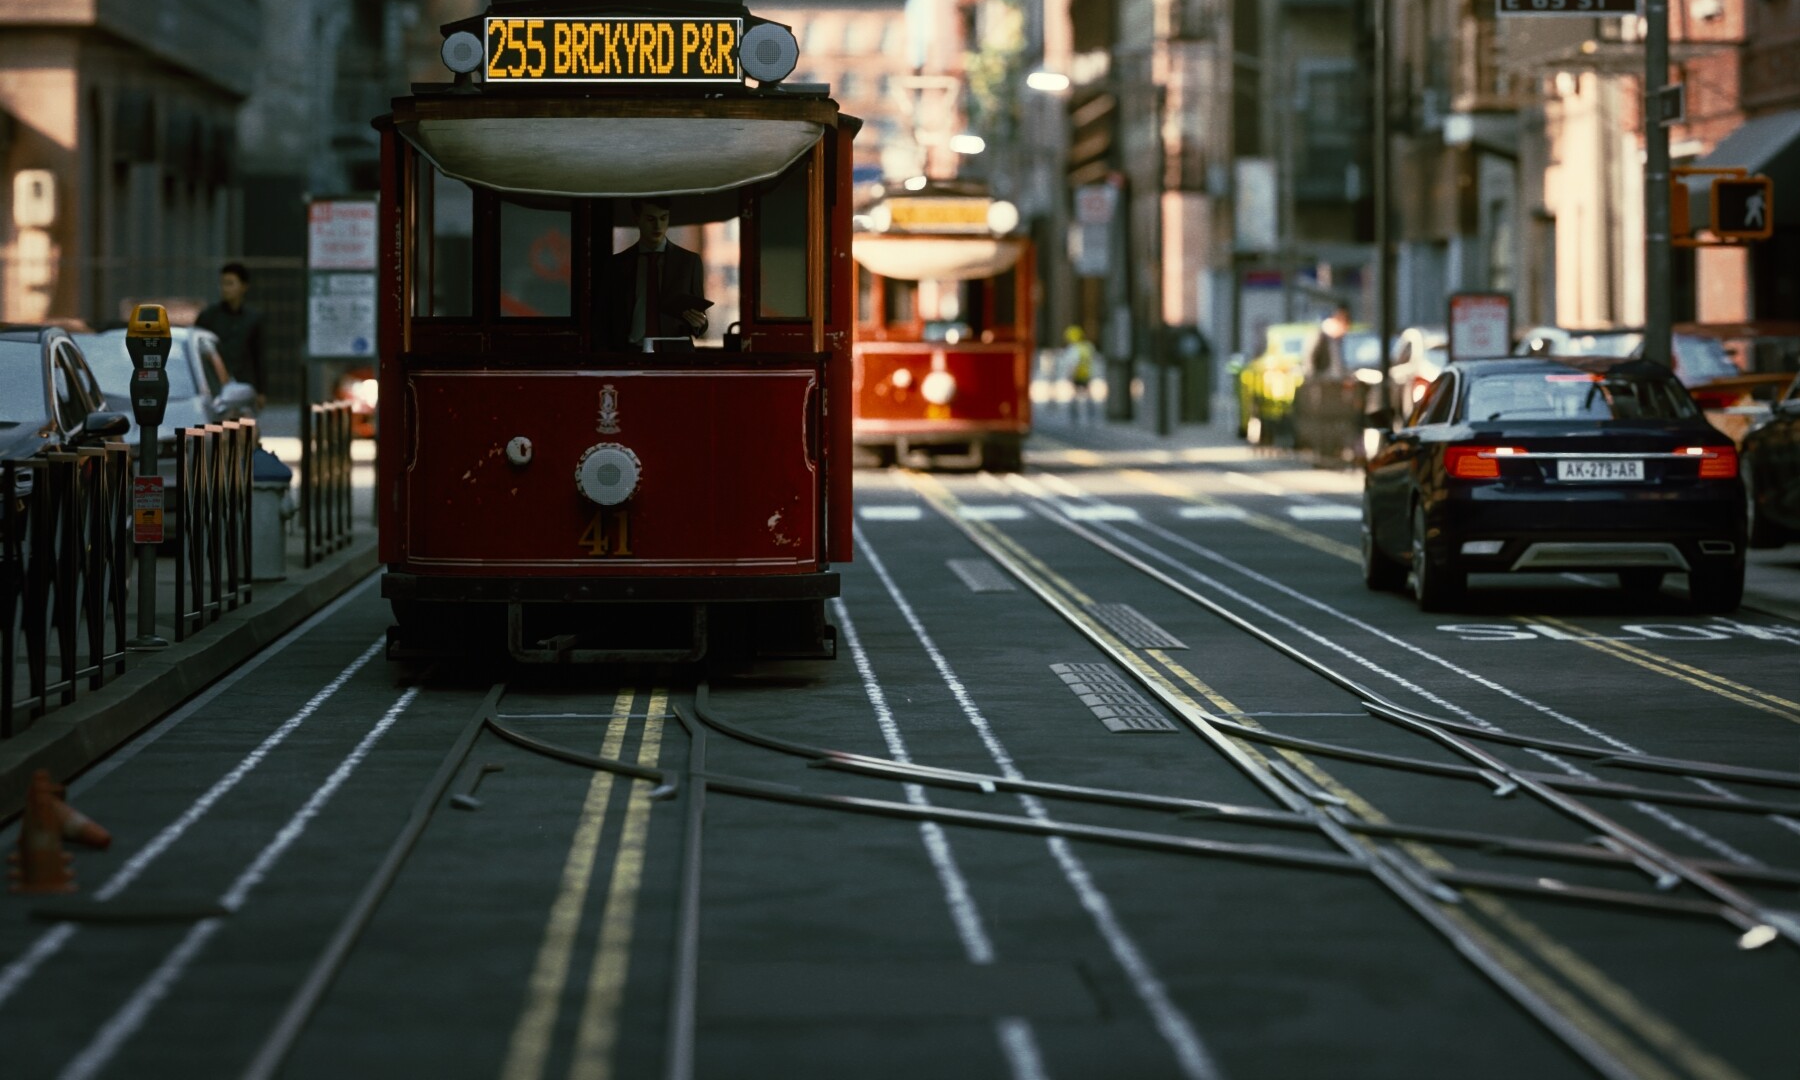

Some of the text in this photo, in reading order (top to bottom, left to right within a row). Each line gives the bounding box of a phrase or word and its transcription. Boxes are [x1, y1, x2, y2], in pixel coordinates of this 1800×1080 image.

[487, 19, 735, 78] 255 BRCKYRD P&R
[578, 510, 634, 556] 41
